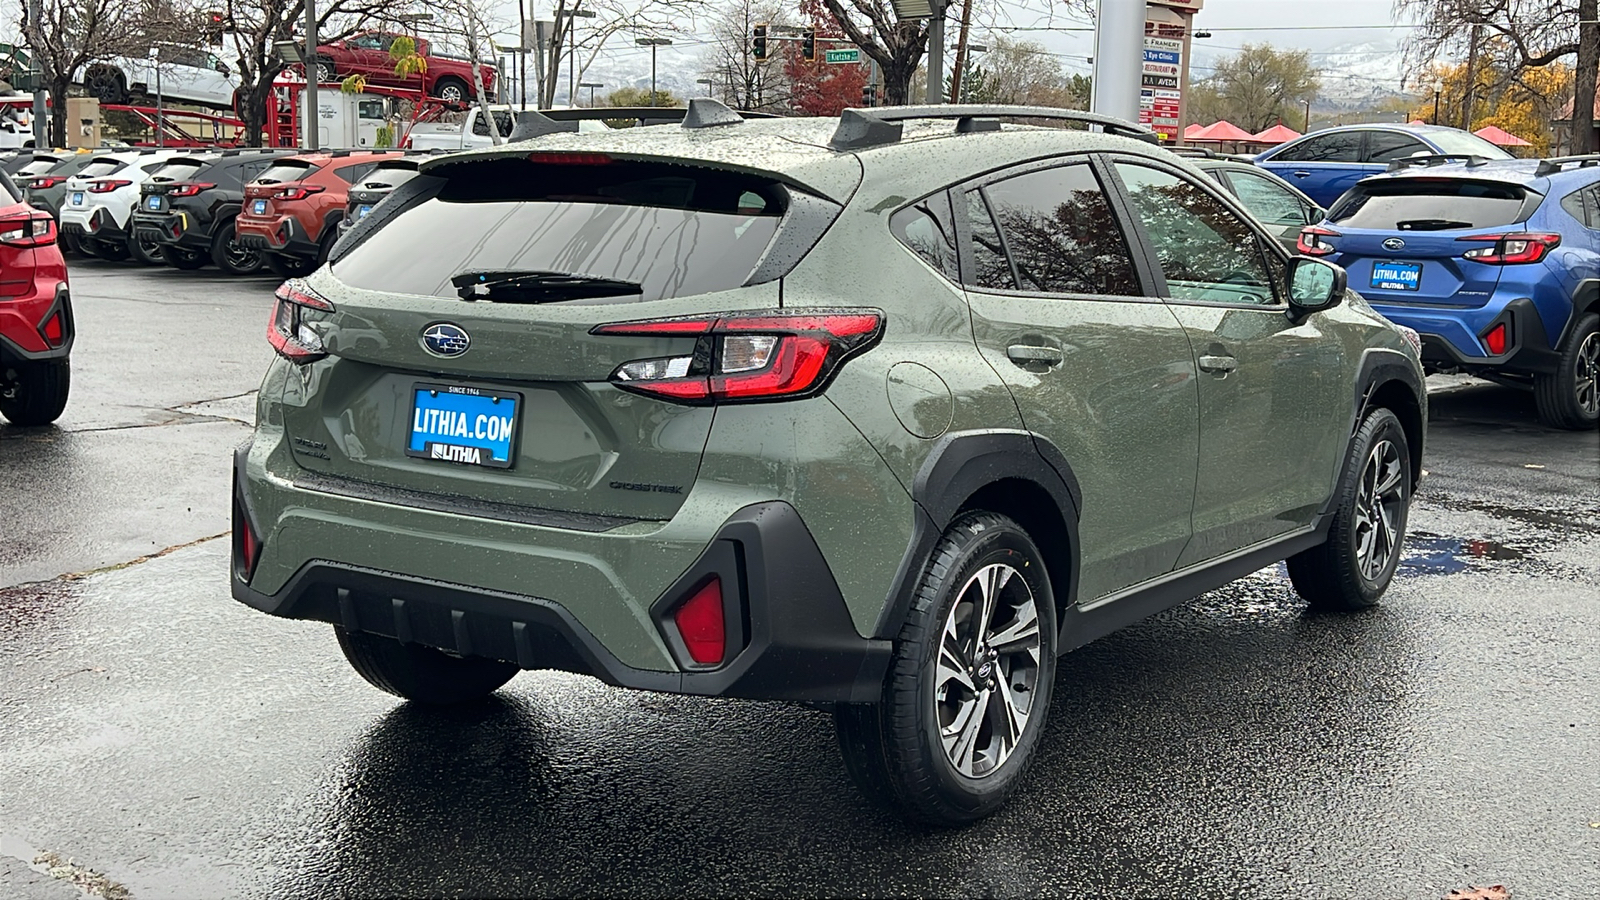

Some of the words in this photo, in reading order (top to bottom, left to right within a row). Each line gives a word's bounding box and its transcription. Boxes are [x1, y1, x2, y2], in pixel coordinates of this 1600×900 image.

[831, 53, 851, 61] Kietzke
[1148, 52, 1158, 61] Eye
[1159, 52, 1173, 61] Clinic
[1144, 63, 1171, 73] RESTAURANT
[1157, 78, 1177, 87] AVEDA
[1372, 269, 1419, 282] LITHIA.COM
[1387, 282, 1404, 290] LITHIA
[448, 386, 466, 395] SINCE
[466, 387, 480, 396] 1946
[413, 407, 514, 443] LITHIA.COM
[443, 444, 481, 465] LITHIA
[609, 481, 683, 494] CROSSTREK
